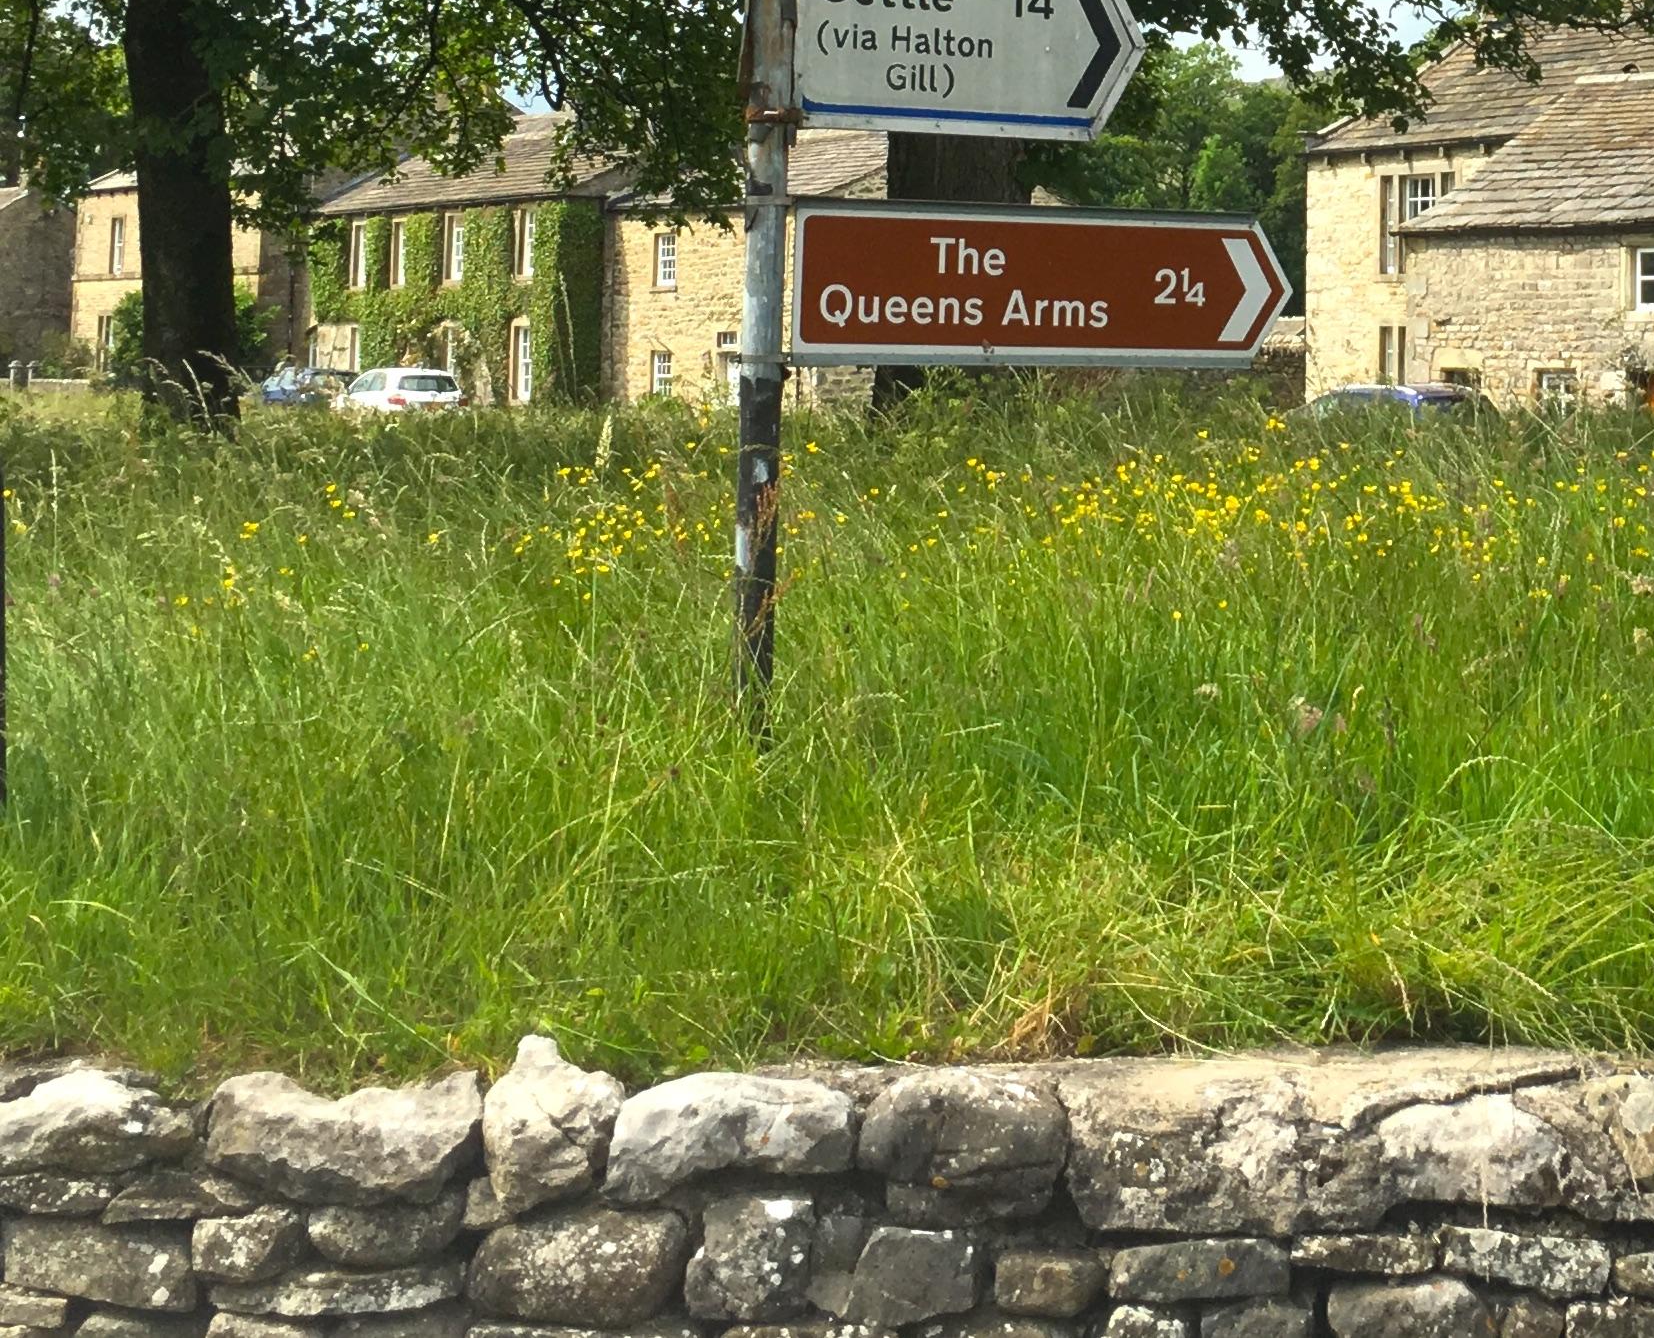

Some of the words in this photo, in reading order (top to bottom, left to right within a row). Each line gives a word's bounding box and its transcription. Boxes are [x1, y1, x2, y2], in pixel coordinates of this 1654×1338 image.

[817, 20, 877, 57] (via
[891, 26, 993, 59] Halton
[885, 63, 955, 98] Gill)
[930, 237, 1006, 277] The
[819, 283, 983, 330] Queens
[1001, 290, 1109, 329] Arms
